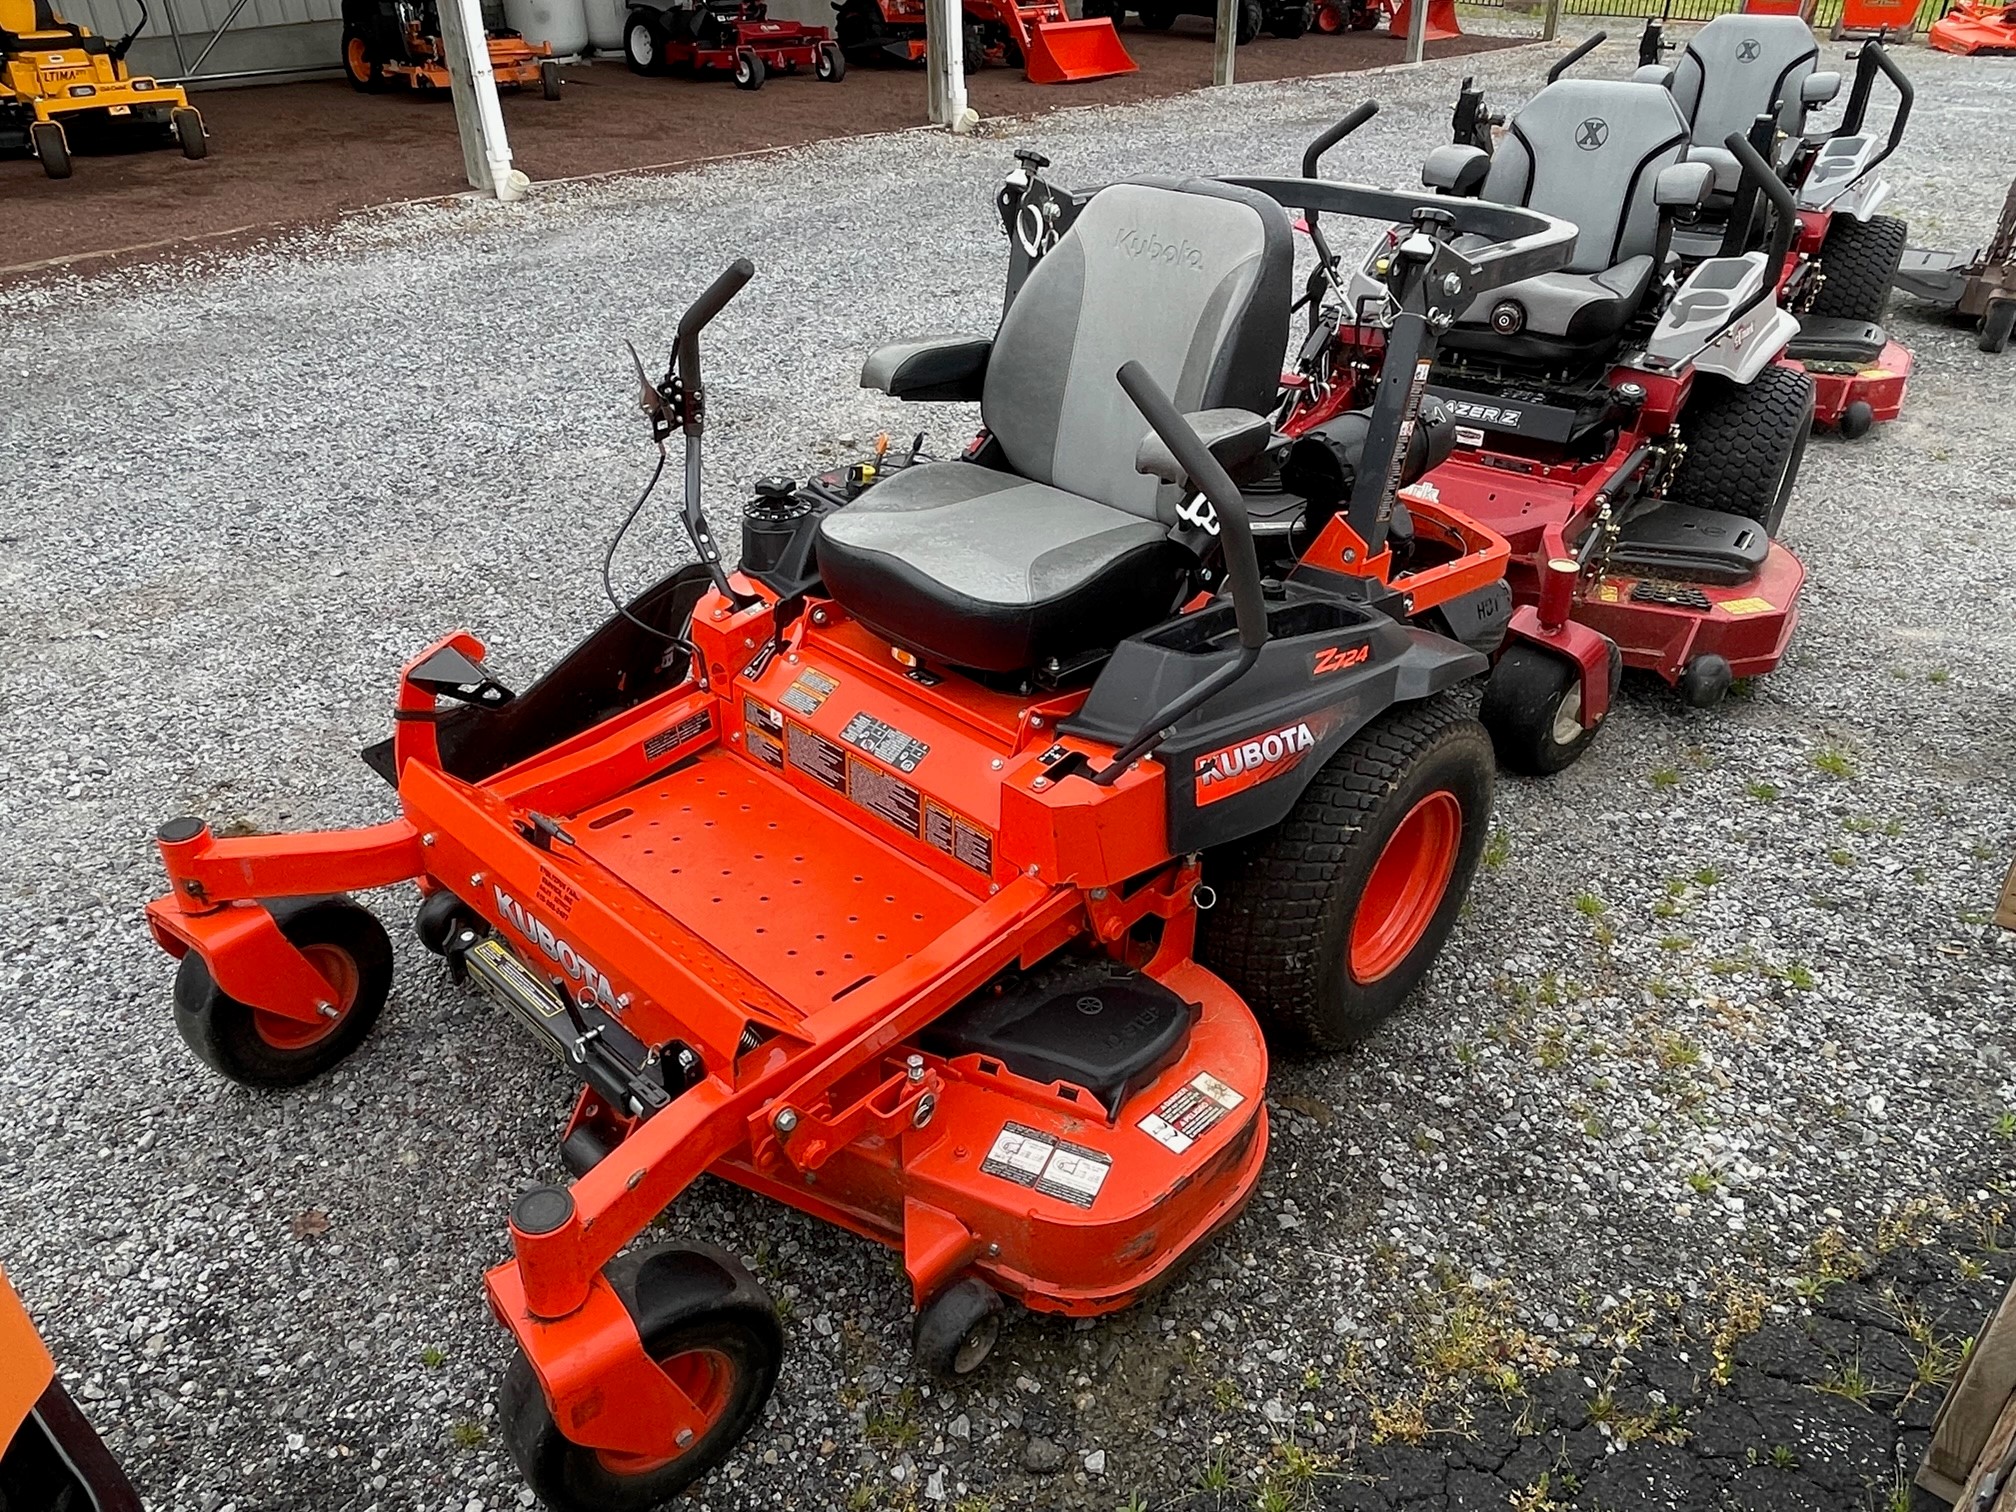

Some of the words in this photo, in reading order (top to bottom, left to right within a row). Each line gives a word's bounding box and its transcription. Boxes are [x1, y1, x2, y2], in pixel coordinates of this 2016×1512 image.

[42, 69, 76, 82] LTIMA
[1114, 228, 1202, 268] Kubota
[1443, 400, 1500, 424] AZER
[1313, 644, 1369, 675] Z724
[1200, 722, 1315, 786] KUBOTA
[493, 884, 621, 1017] KUBOTA
